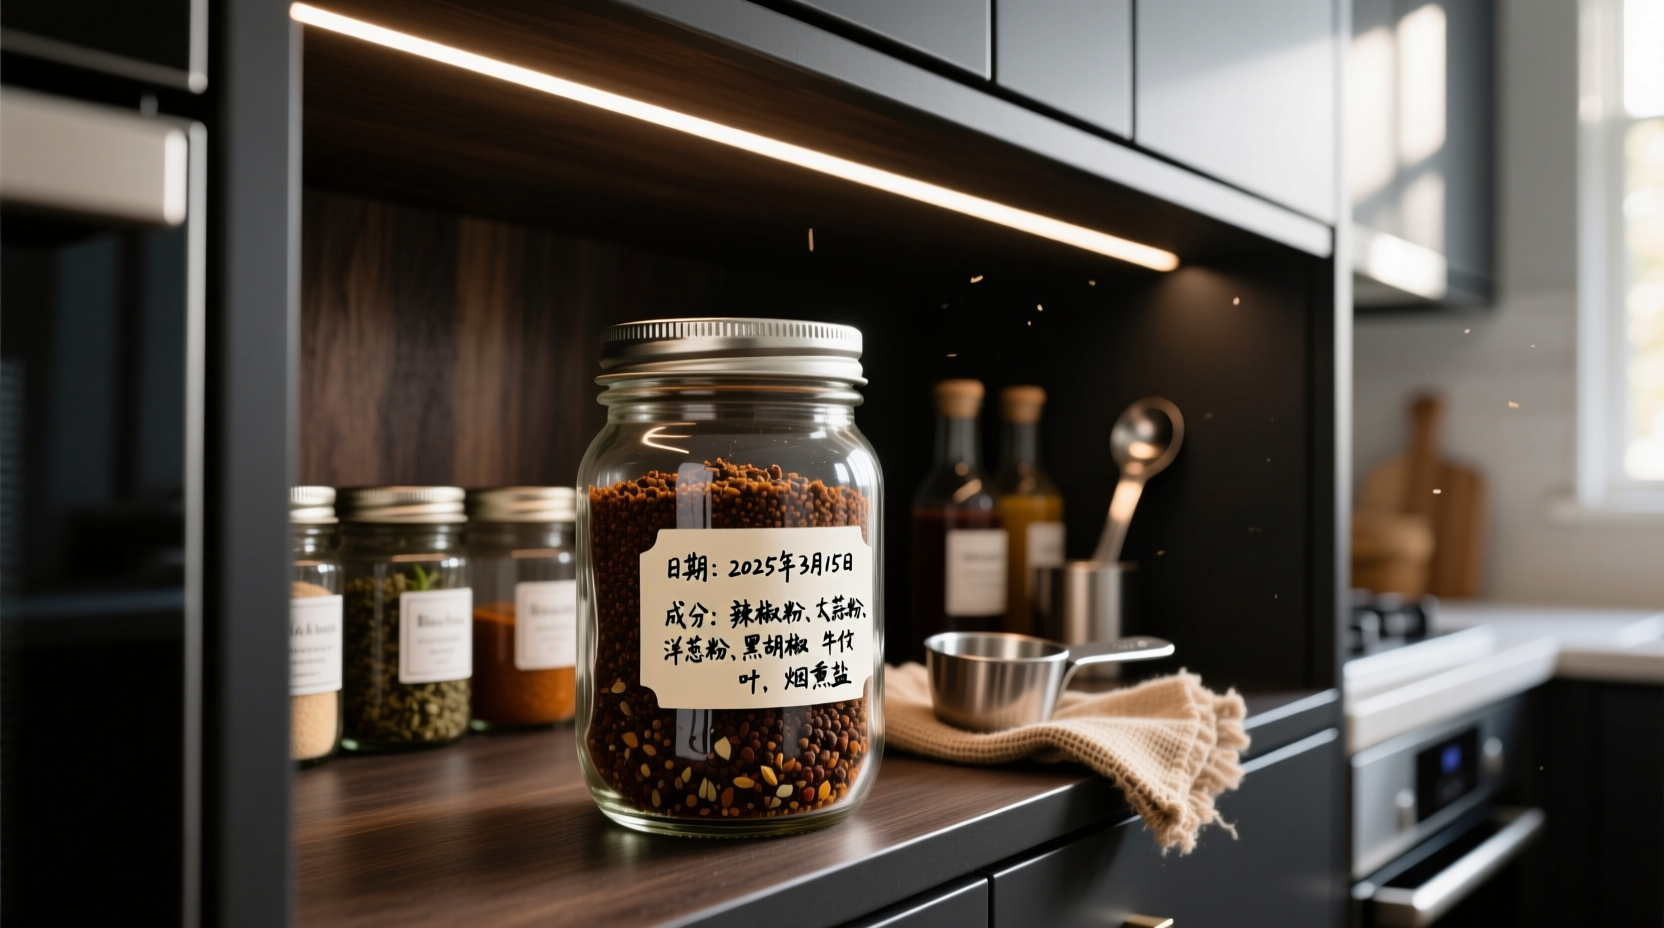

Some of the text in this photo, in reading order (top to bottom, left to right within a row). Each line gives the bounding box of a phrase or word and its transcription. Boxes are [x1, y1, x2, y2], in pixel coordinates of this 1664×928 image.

[667, 550, 853, 583] 日期：2025年3月15日
